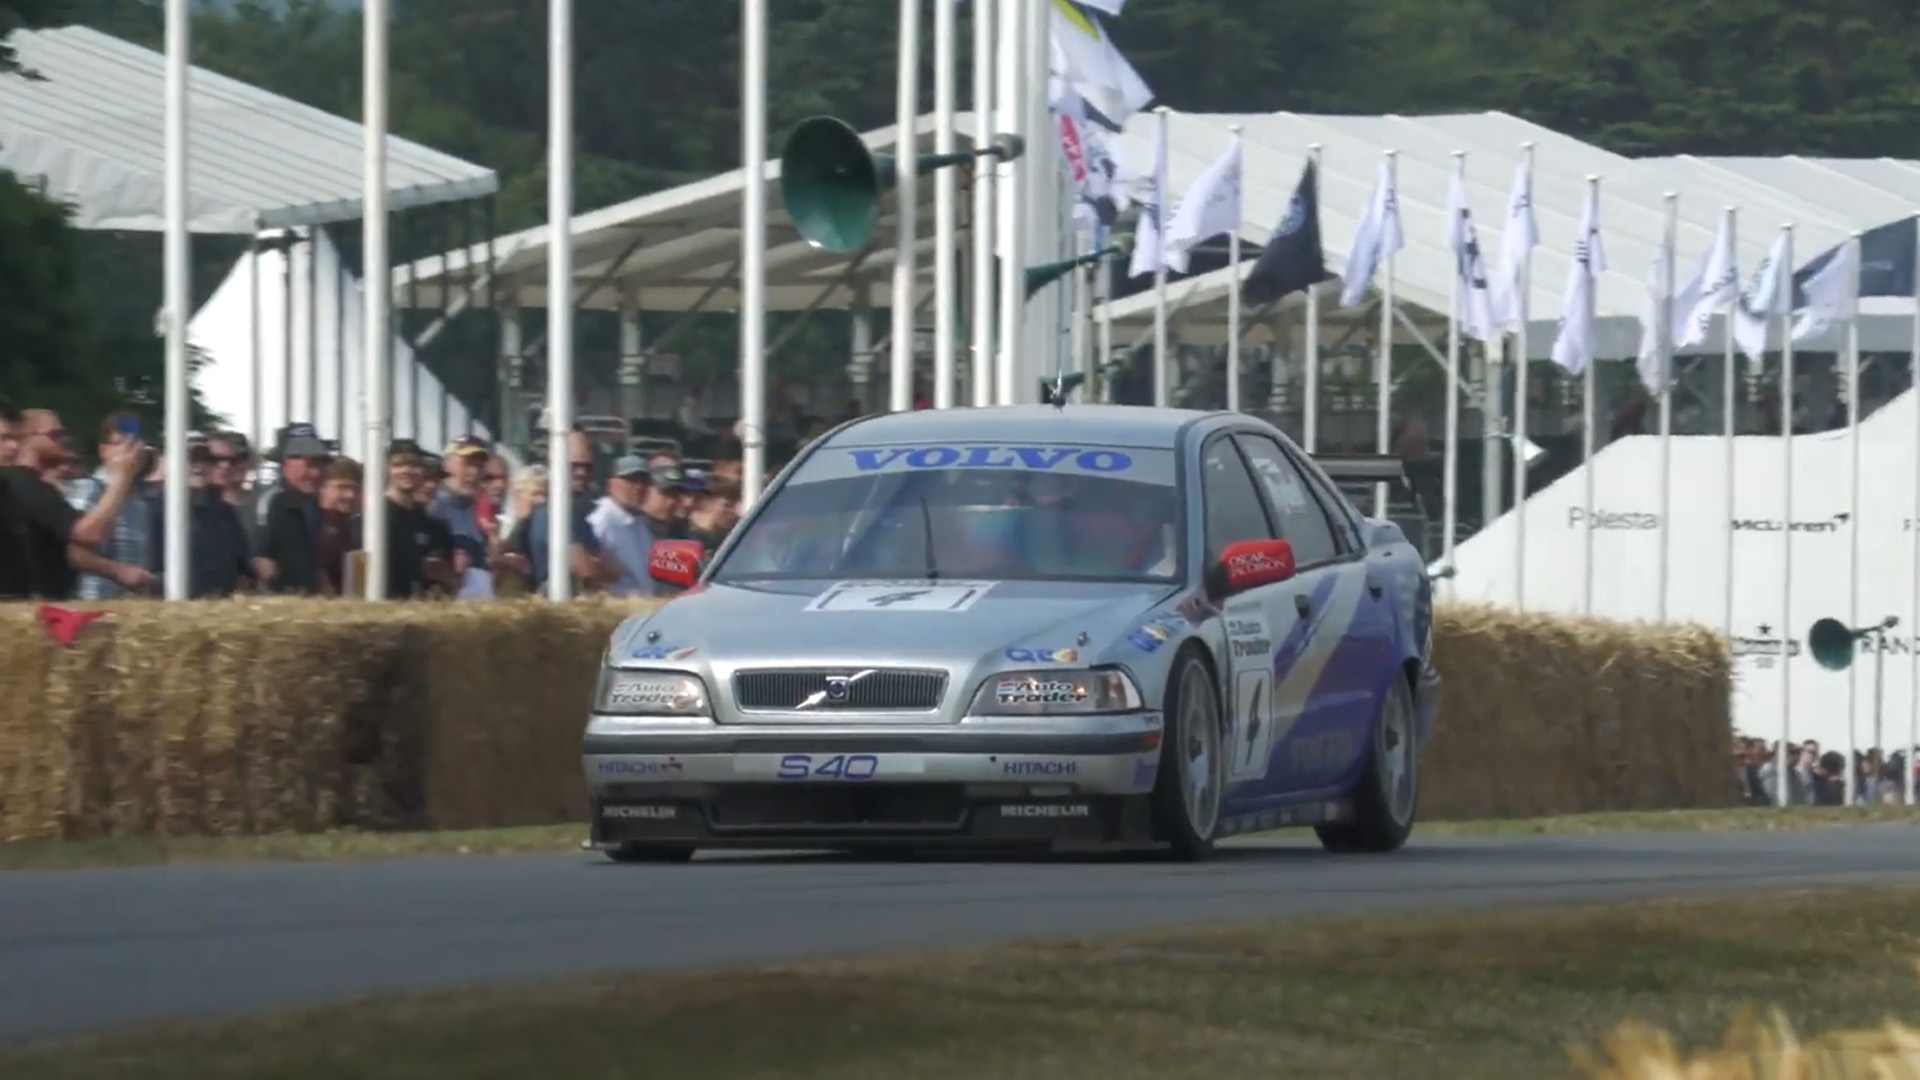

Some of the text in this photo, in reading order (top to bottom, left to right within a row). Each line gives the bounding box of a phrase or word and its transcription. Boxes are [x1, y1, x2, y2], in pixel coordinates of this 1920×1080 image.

[848, 447, 1133, 473] VOLVO
[866, 590, 933, 607] 4
[1016, 681, 1072, 692] Auto
[998, 692, 1087, 703] Trader
[599, 762, 658, 774] HITACHI
[778, 755, 879, 780] S40
[1003, 761, 1077, 775] HITACHI
[602, 805, 677, 819] MICHELIN
[1000, 805, 1089, 817] MICHELIN
